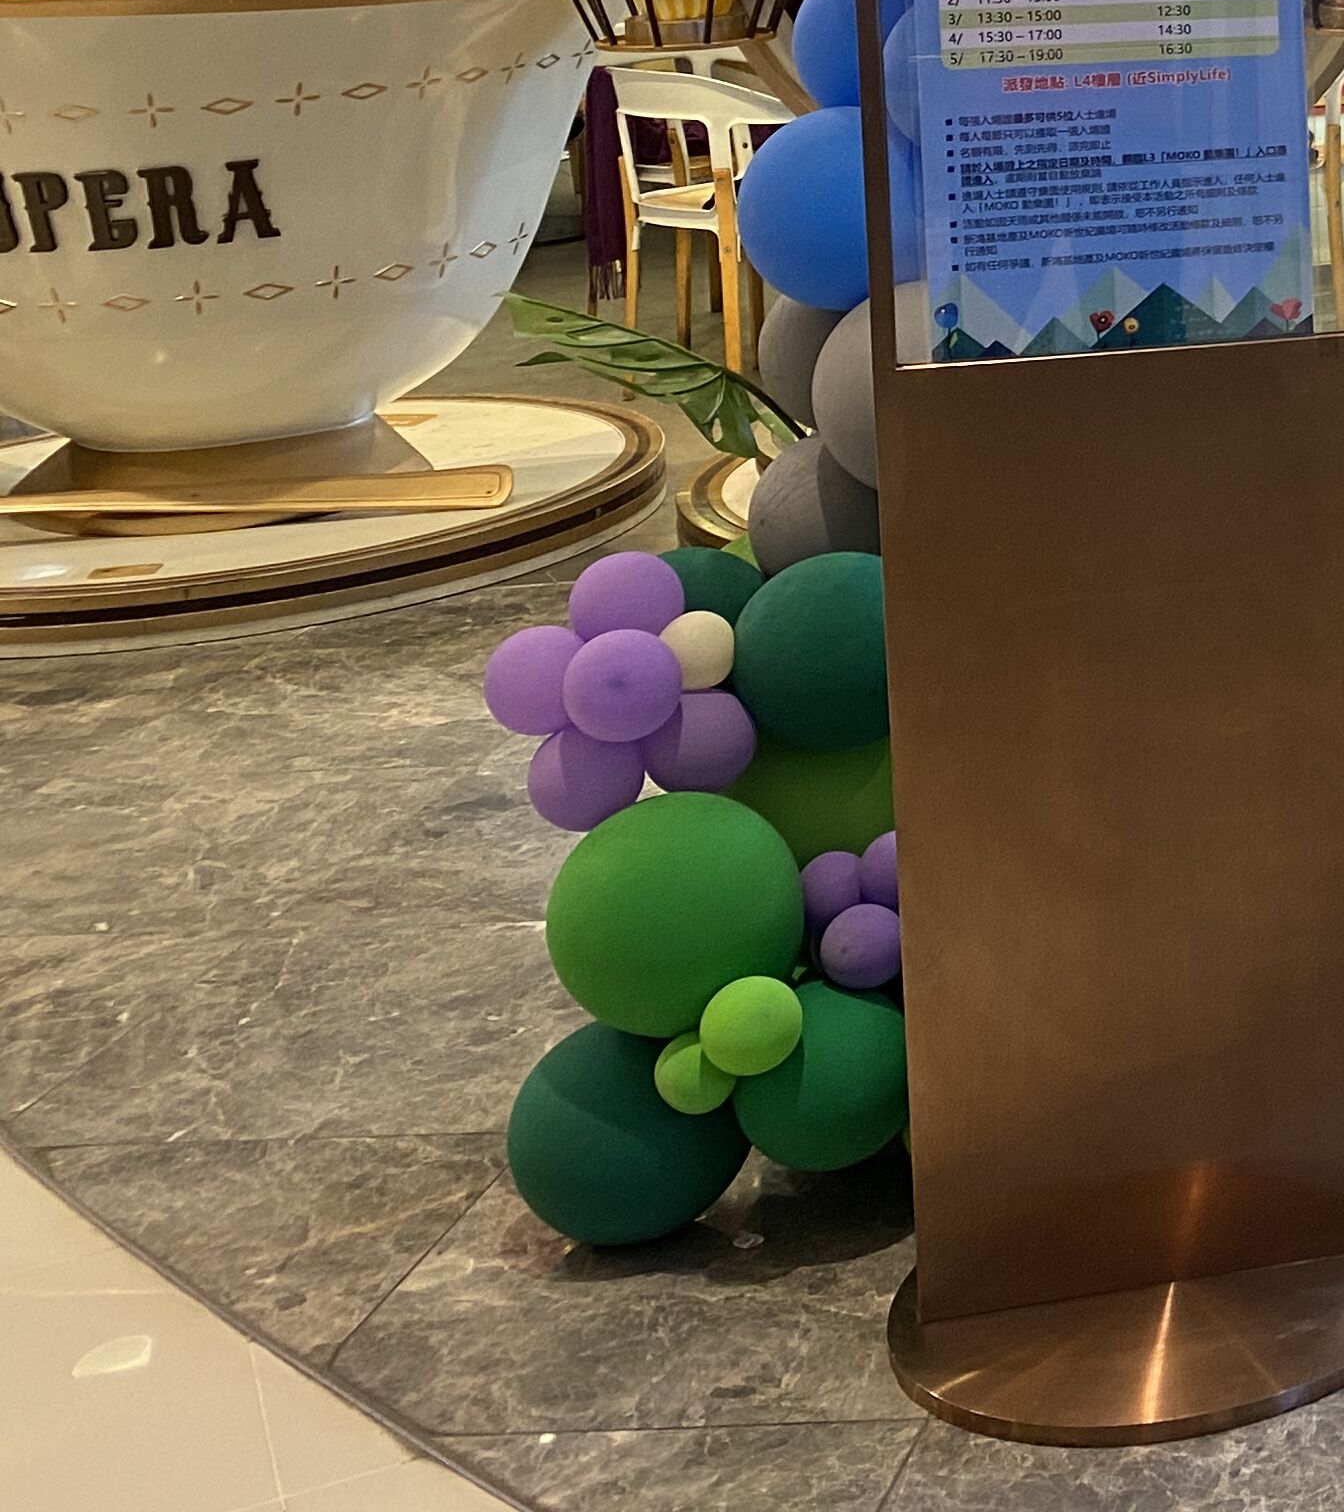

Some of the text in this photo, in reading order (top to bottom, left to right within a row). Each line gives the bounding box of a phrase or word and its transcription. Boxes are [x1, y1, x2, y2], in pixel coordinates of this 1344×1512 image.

[948, 13, 962, 26] 3/
[978, 11, 1012, 23] 13:30
[1027, 9, 1062, 22] 15:00
[1157, 5, 1191, 17] 12:30
[948, 32, 963, 45] 4/
[978, 30, 1013, 43] 15:30
[1028, 29, 1062, 41] 17:00
[1158, 24, 1192, 36] 14:30
[950, 52, 964, 65] 5/
[980, 50, 1014, 63] 17:30
[1029, 48, 1063, 61] 19:00
[1159, 43, 1193, 55] 16:30
[0, 159, 281, 253] PERA
